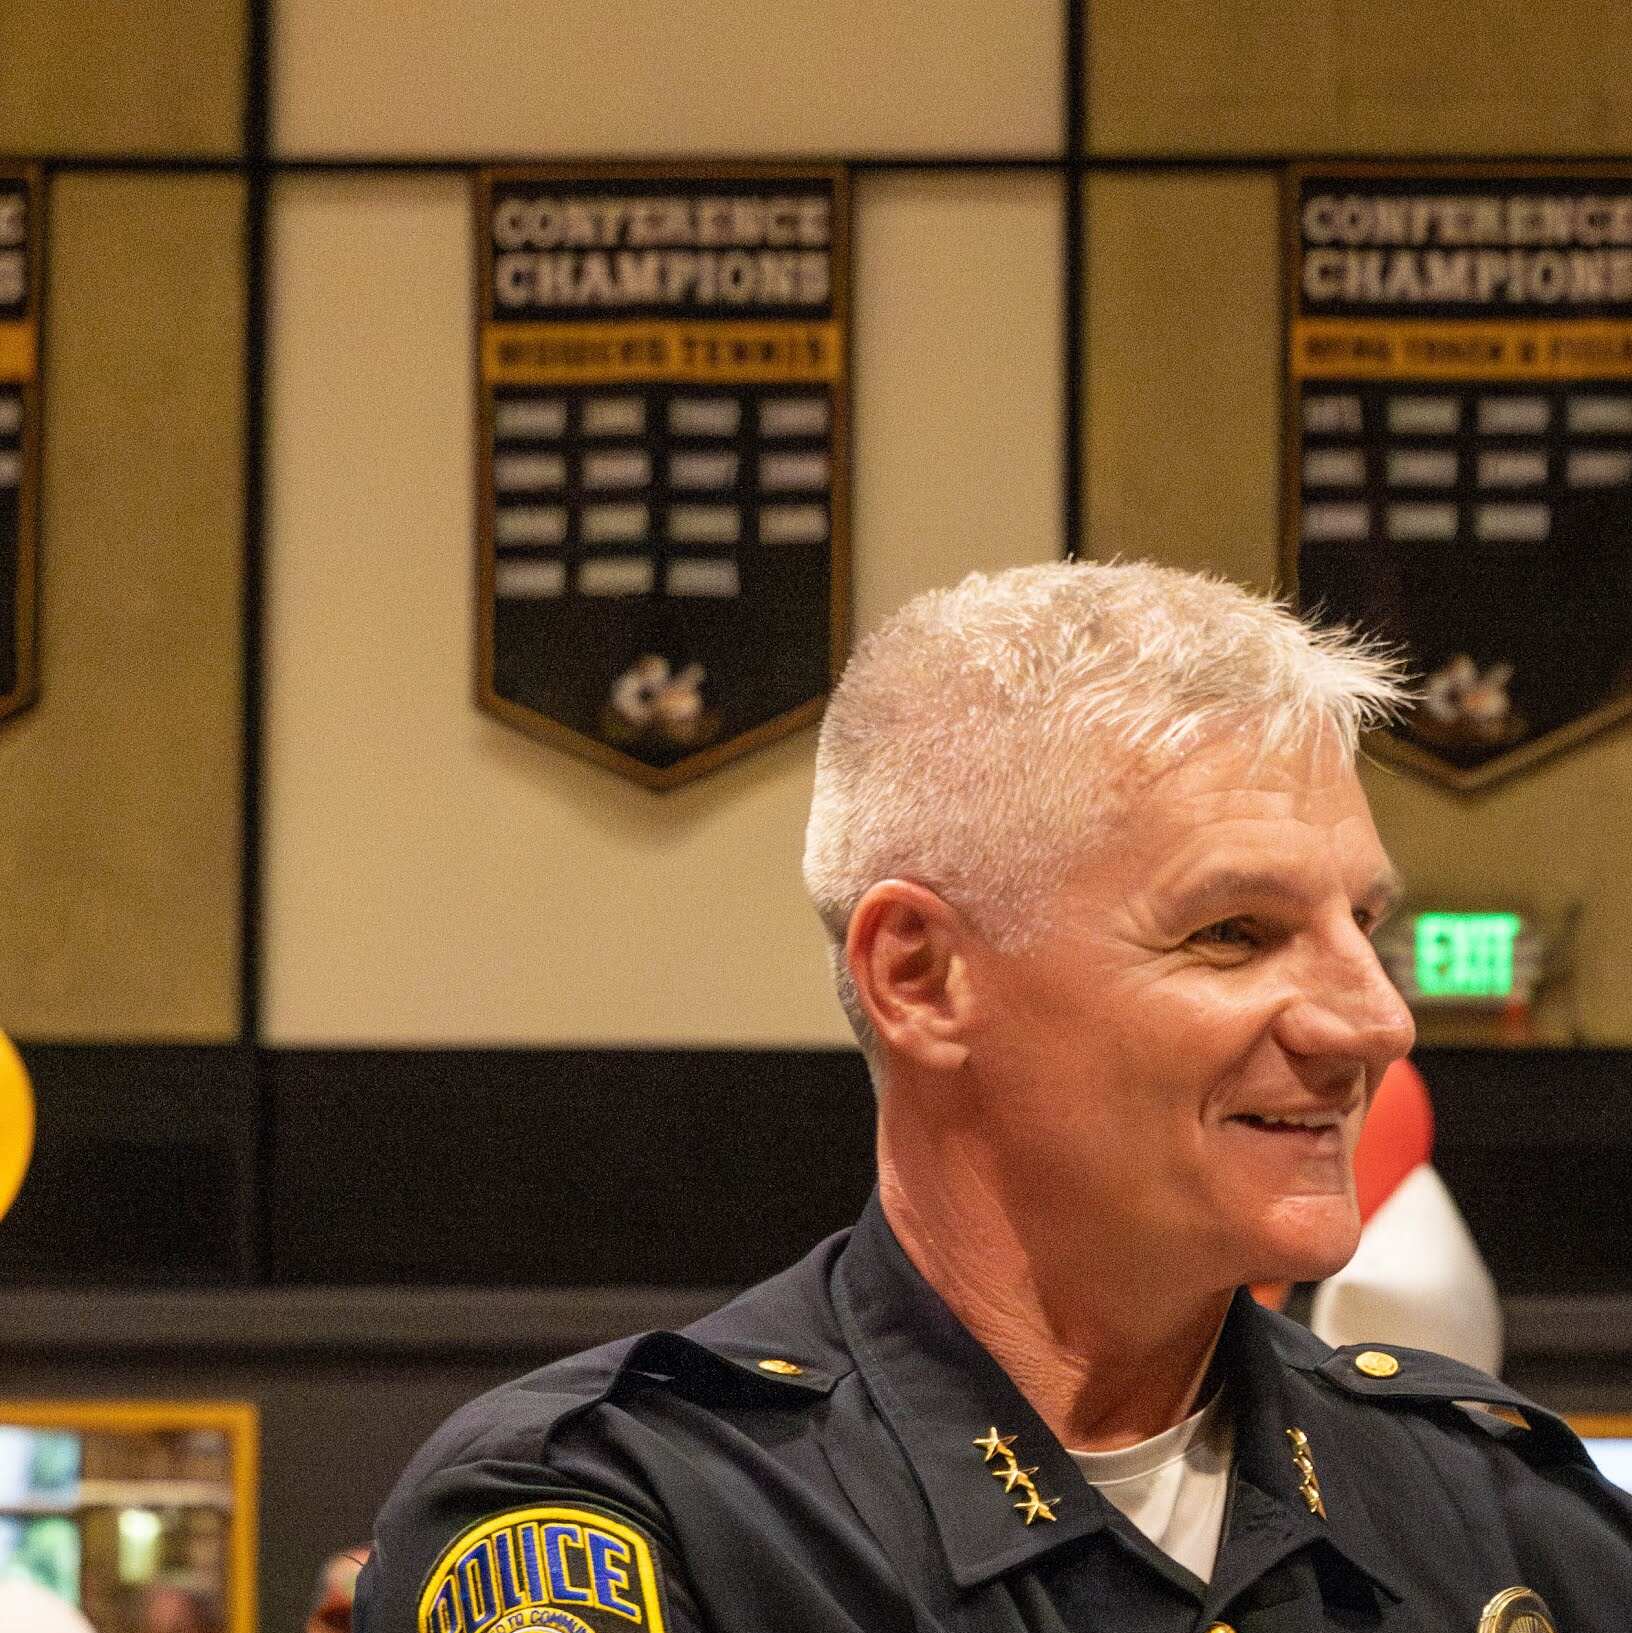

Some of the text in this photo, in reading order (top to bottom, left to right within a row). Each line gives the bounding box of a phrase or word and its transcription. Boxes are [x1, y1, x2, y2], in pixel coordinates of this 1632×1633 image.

[495, 197, 833, 245] CONFERENCE
[495, 250, 833, 304] CHAMPIONS
[1417, 914, 1519, 995] EXIT
